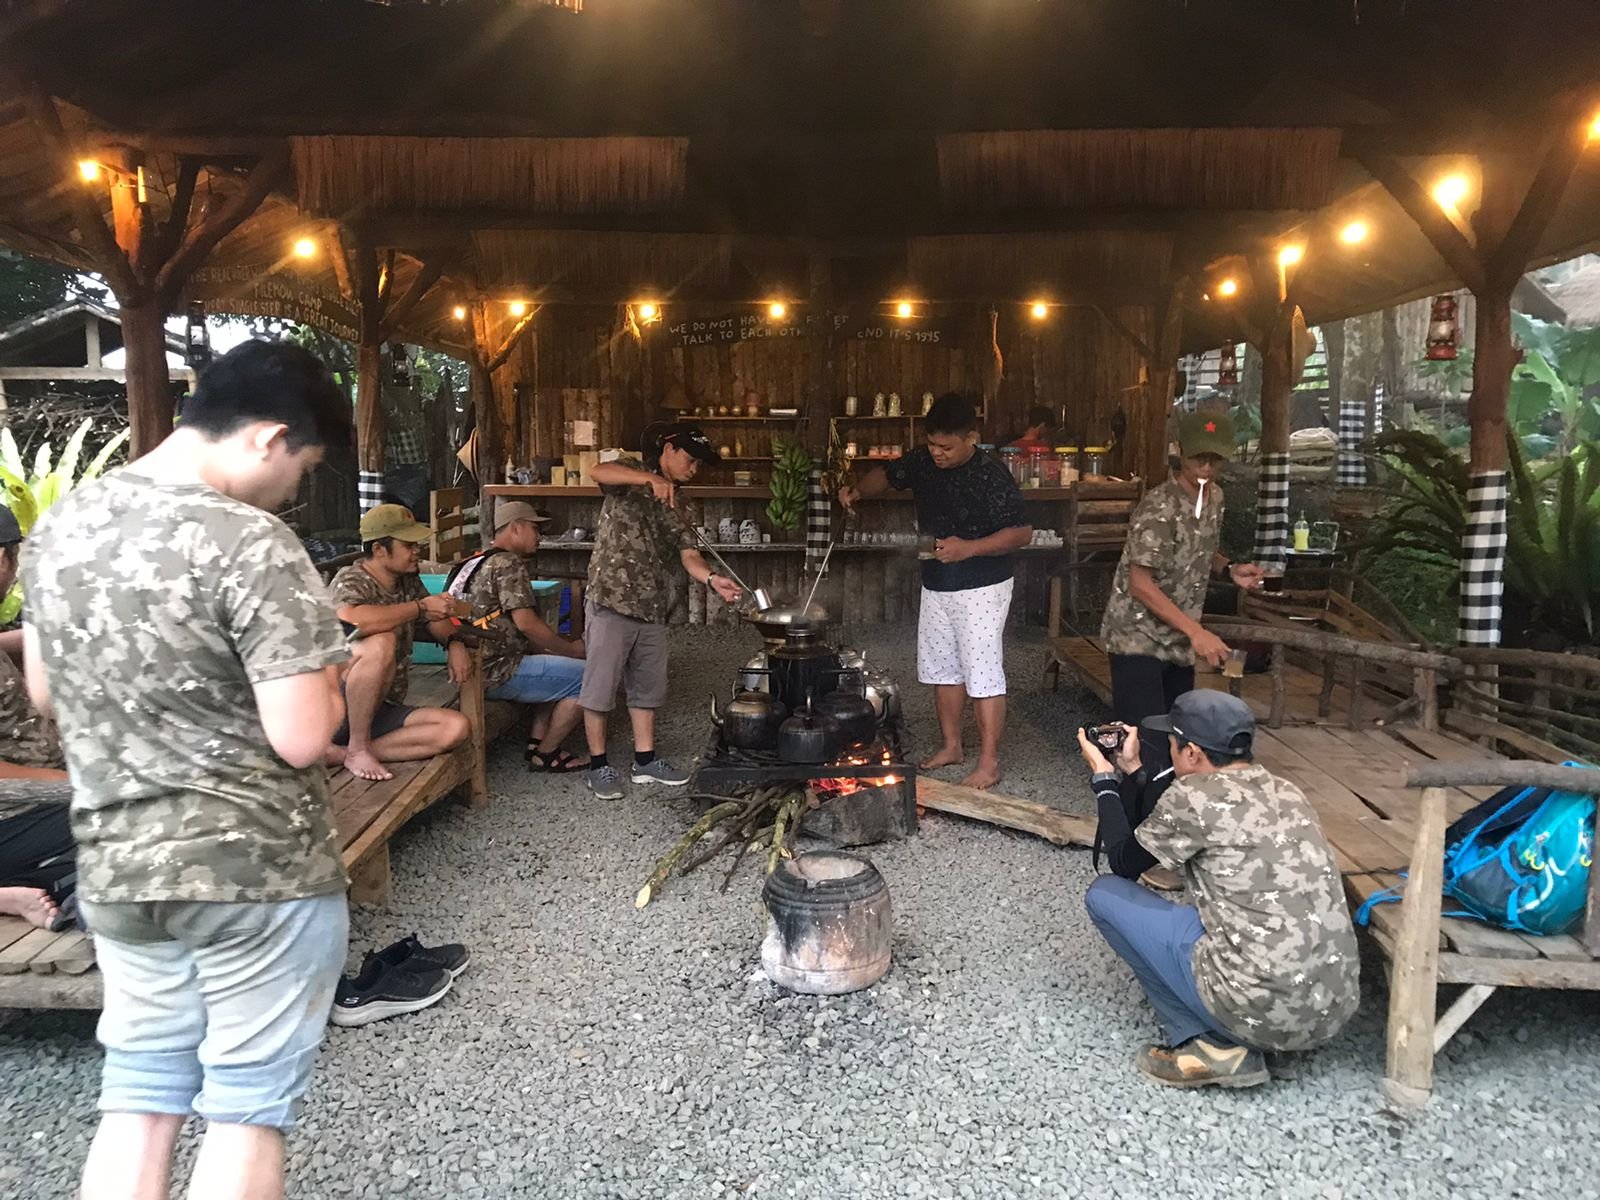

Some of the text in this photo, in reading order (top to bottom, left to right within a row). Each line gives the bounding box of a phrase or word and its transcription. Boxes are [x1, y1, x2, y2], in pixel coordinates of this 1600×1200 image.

[298, 291, 323, 311] CAMP
[260, 301, 280, 316] STEP
[284, 303, 292, 318] IS
[294, 306, 301, 321] A
[303, 307, 329, 330] GREAT
[669, 323, 687, 334] WE
[693, 322, 706, 332] DO
[710, 318, 734, 330] NOT
[682, 333, 713, 345] TALK
[719, 330, 734, 341] TO
[740, 327, 772, 340] EACH
